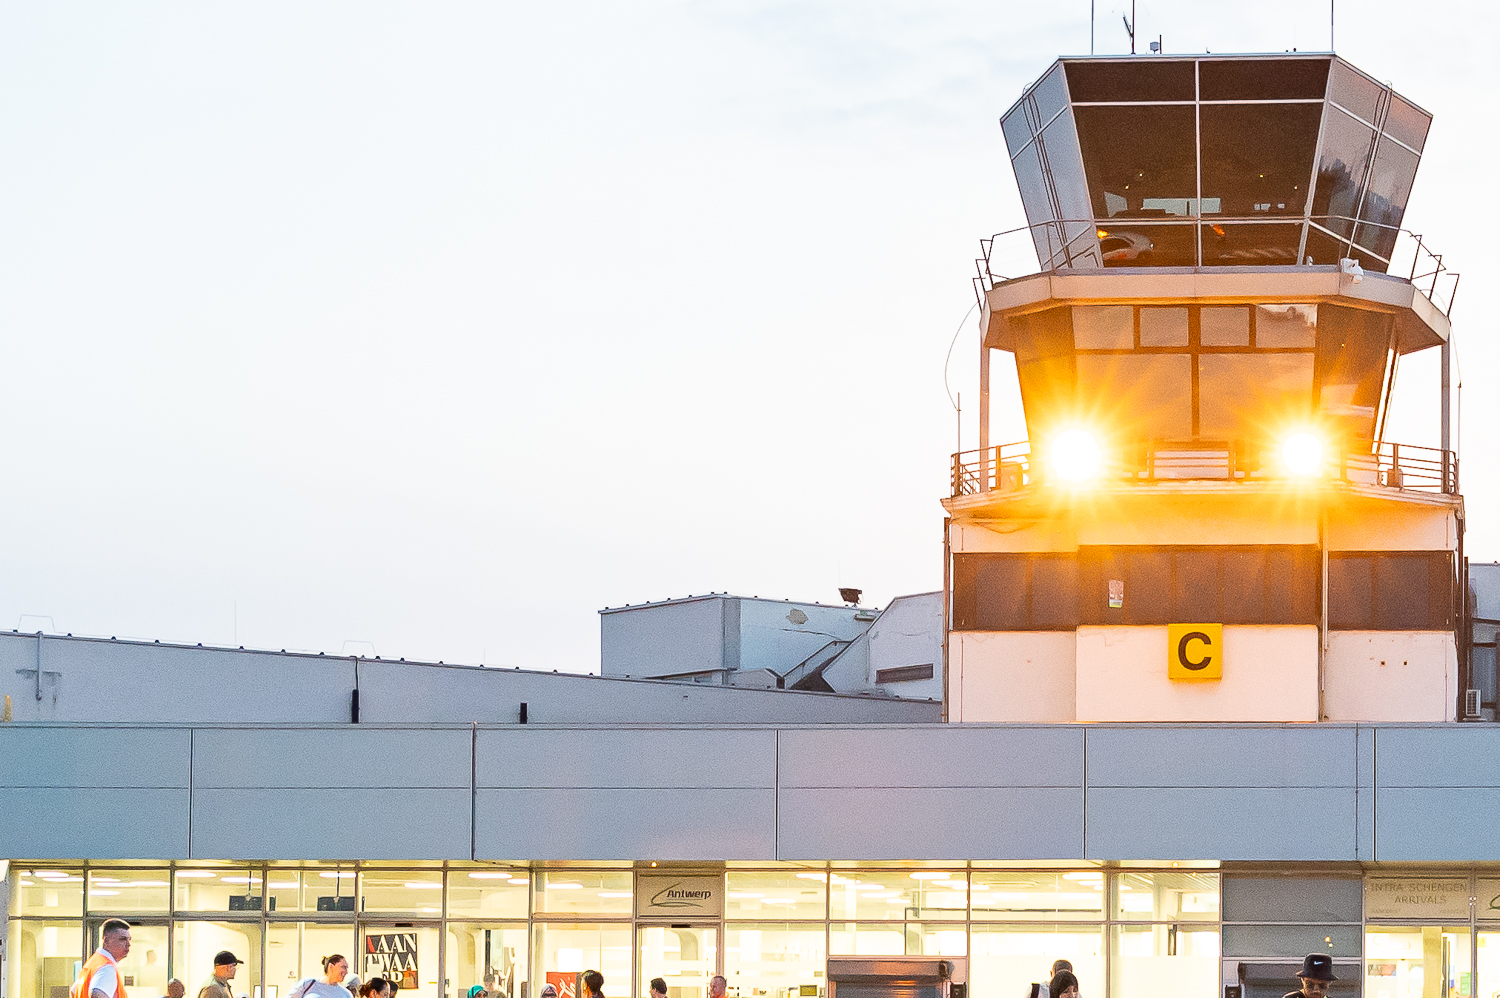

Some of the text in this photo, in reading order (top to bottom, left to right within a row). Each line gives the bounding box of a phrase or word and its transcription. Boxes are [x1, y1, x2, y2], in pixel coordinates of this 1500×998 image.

[1178, 632, 1212, 671] C
[1371, 883, 1467, 892] INTRA SCHENGEN
[667, 890, 711, 899] Antwerp
[1394, 895, 1447, 904] ARRIVALS
